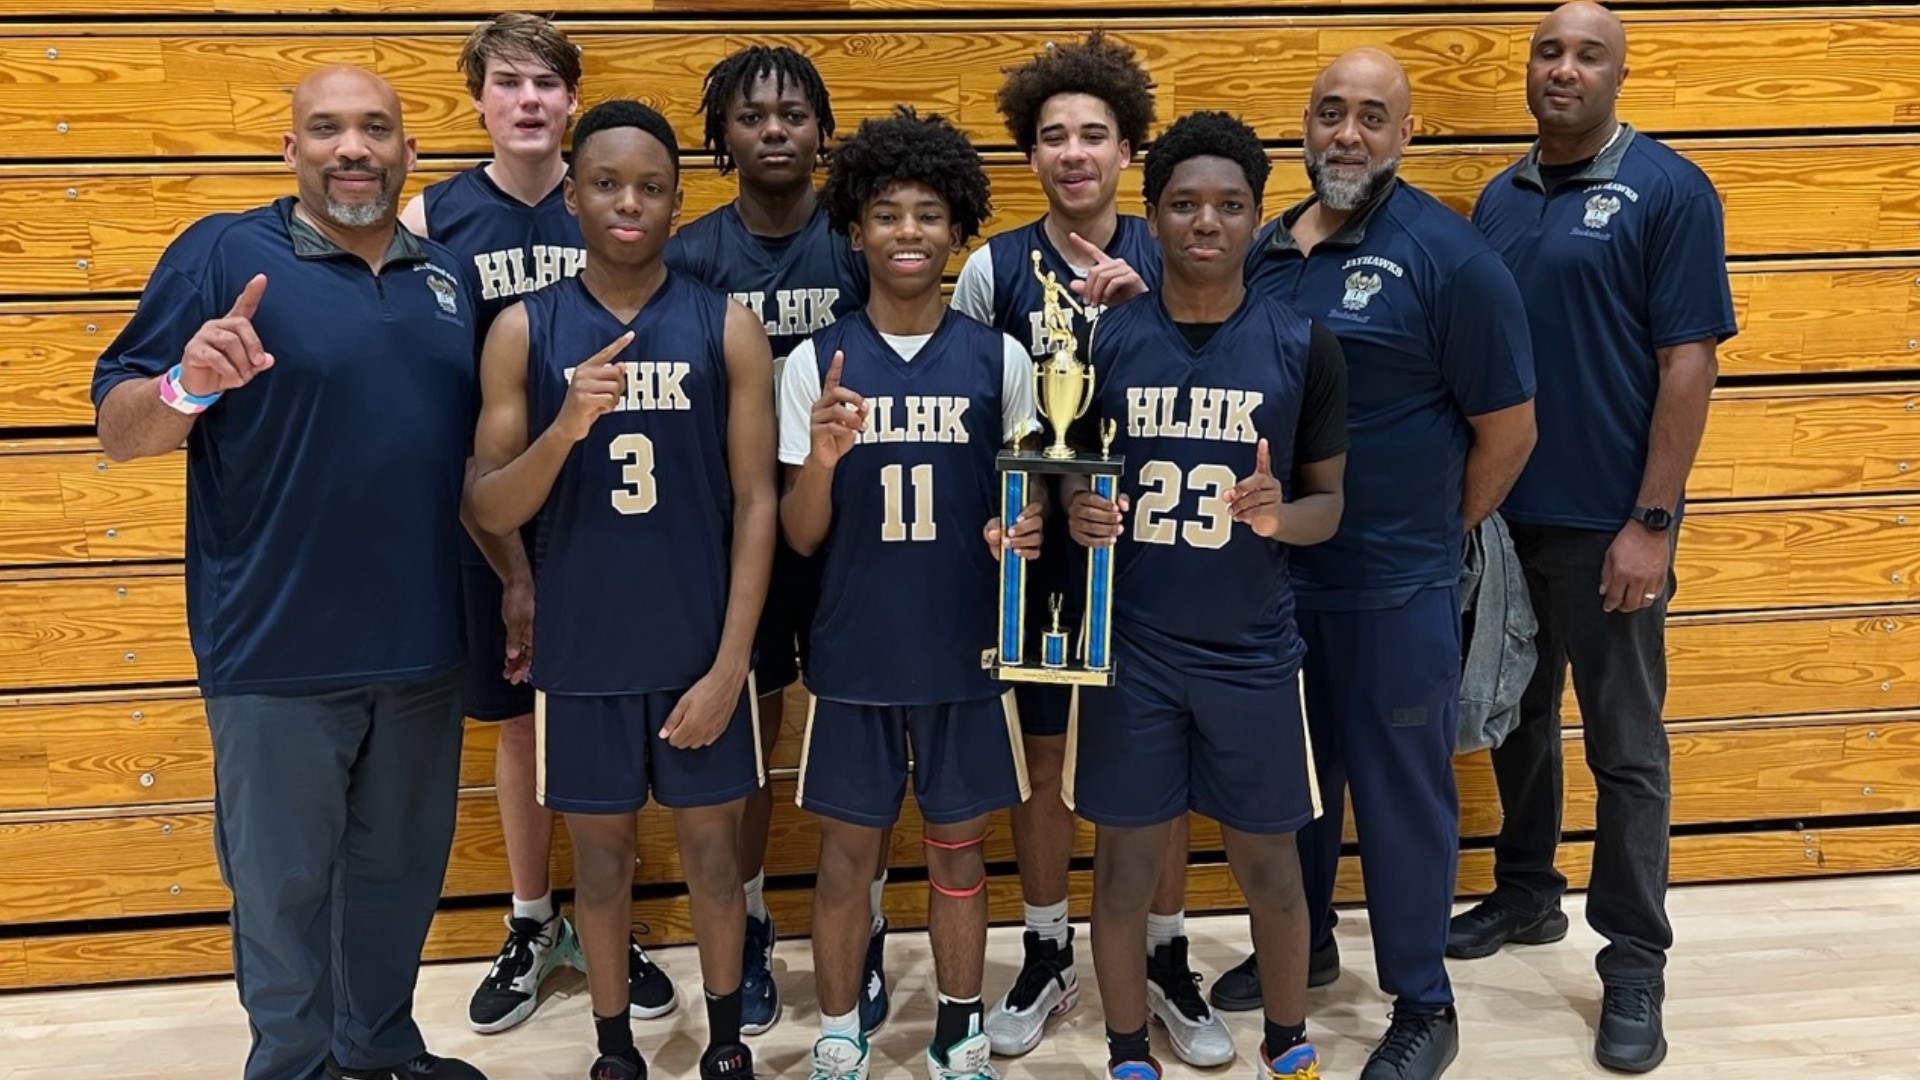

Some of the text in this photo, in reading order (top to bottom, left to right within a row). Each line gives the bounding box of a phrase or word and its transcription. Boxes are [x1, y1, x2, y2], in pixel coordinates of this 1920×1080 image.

[1341, 254, 1404, 277] JAYHAWKS
[728, 288, 840, 335] LHK
[1127, 386, 1264, 444] HLHK
[609, 433, 657, 515] 3
[881, 463, 937, 541] 11
[1133, 460, 1237, 549] 23
